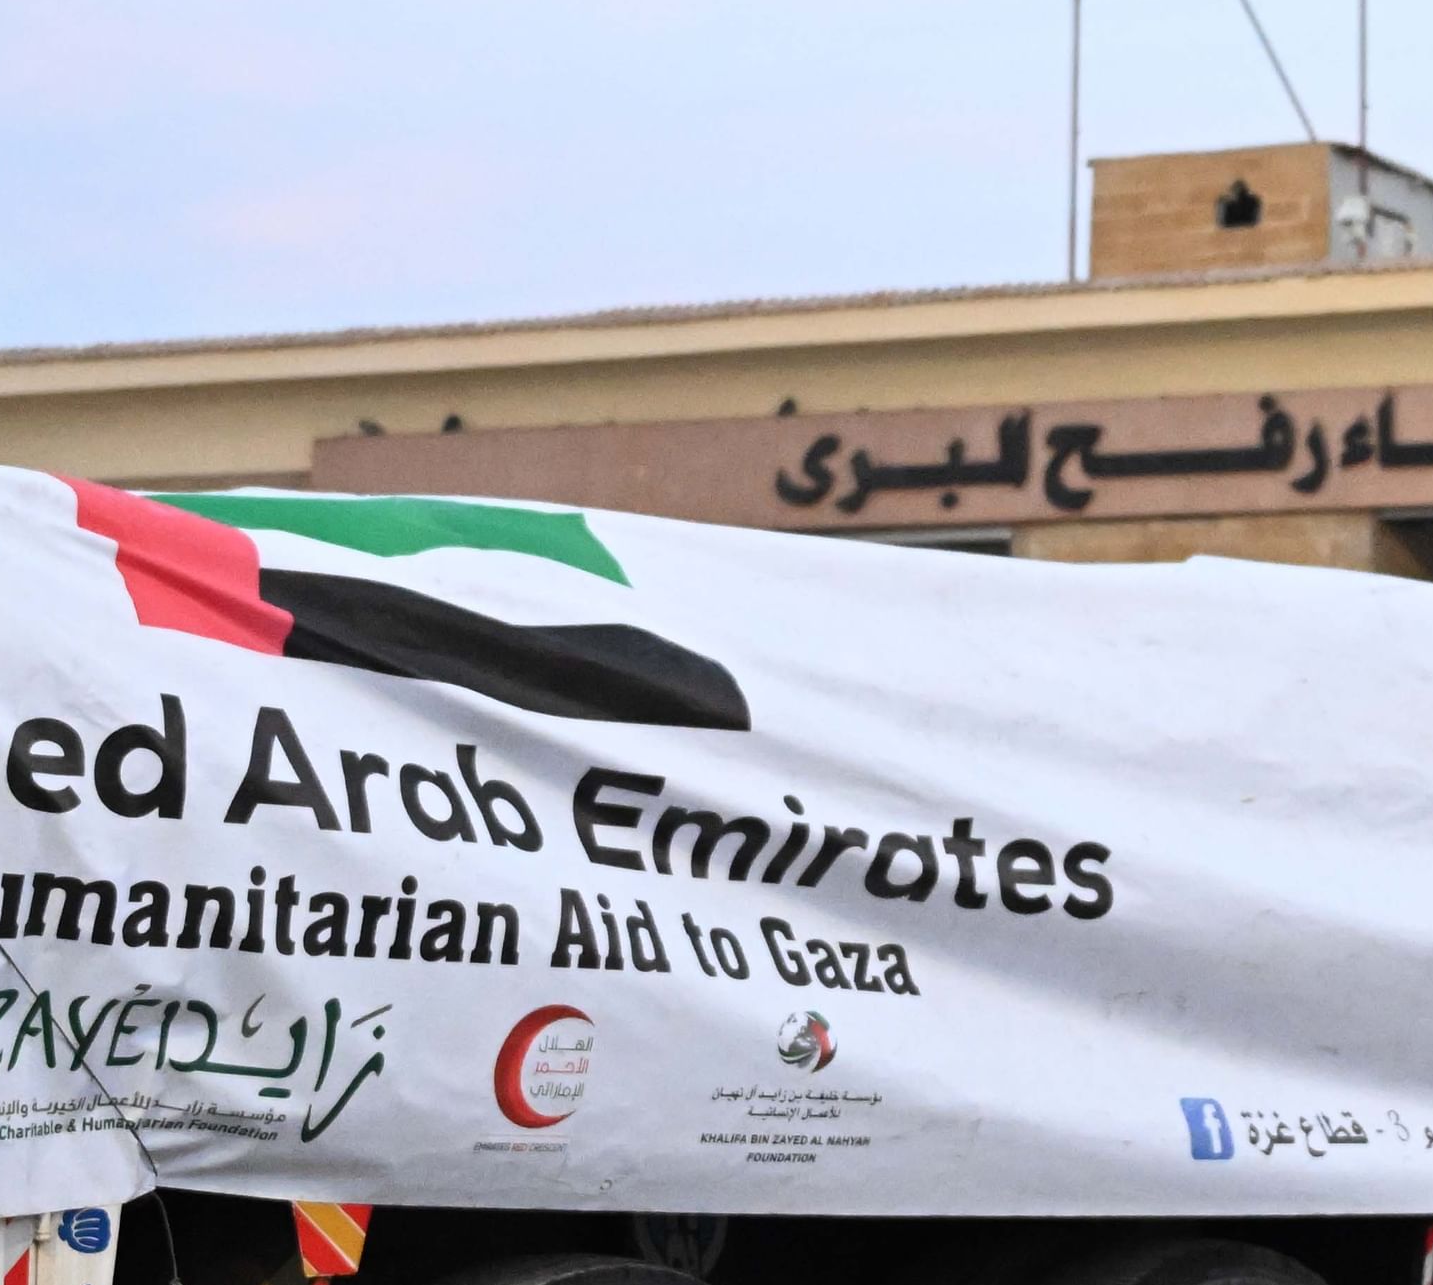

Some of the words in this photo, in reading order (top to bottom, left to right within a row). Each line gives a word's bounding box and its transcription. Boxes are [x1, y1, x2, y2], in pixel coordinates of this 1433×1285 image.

[1044, 393, 1328, 510] رفح
[224, 706, 545, 854] Arab
[571, 766, 1116, 922] Emirates
[550, 887, 670, 974] Aid
[681, 911, 751, 982] to
[762, 919, 921, 998] Gaza
[538, 1035, 594, 1053] الهلال
[787, 1091, 803, 1104] بن
[804, 1088, 840, 1105] خليفة
[66, 1119, 77, 1133] &
[187, 1118, 279, 1143] Foundation
[700, 1132, 748, 1145] KHALIFA
[750, 1133, 770, 1145] BIN
[772, 1134, 809, 1146] ZAYED
[809, 1135, 824, 1146] AL
[826, 1134, 872, 1147] NAHYAN
[1240, 1110, 1296, 1156] غزة
[1298, 1110, 1369, 1158] قطاع
[746, 1152, 818, 1164] FOUNDATION
